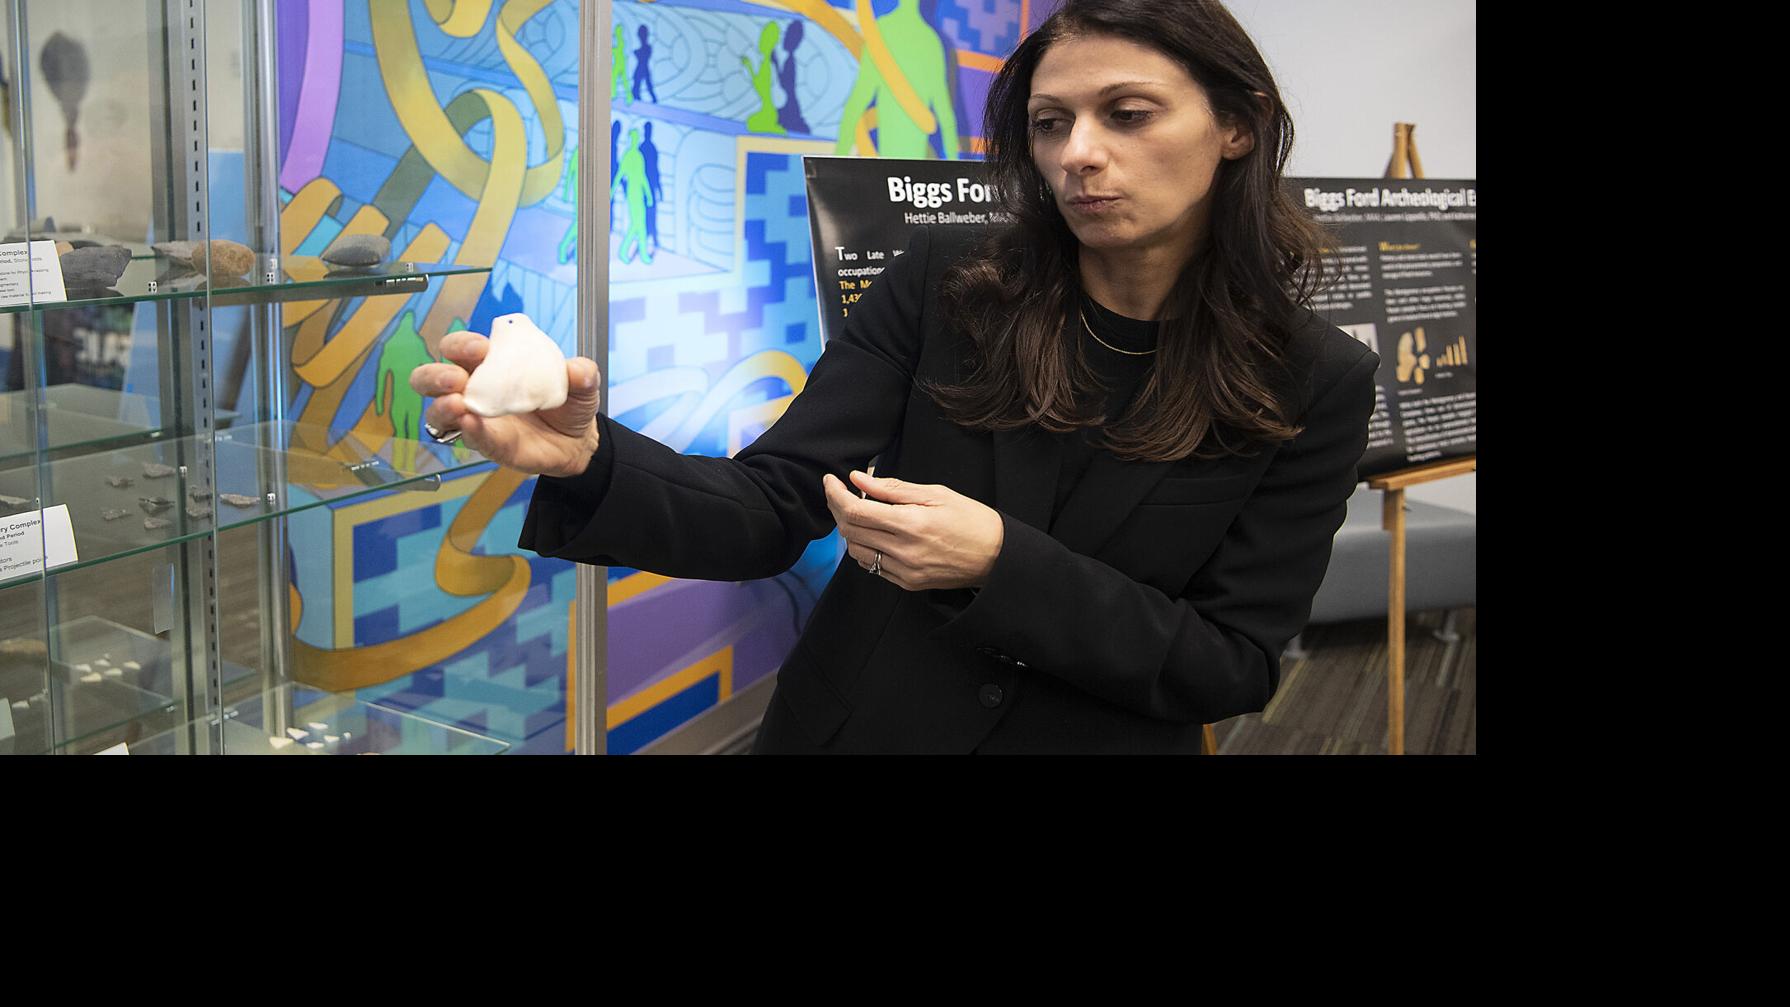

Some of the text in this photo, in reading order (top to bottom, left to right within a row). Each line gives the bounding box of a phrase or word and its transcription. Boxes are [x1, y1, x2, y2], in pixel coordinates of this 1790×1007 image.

[887, 176, 953, 209] Biggs
[1304, 187, 1346, 212] Biggs
[1345, 187, 1380, 208] Ford
[904, 212, 936, 224] Hettie
[937, 211, 988, 225] Ballweber,
[834, 246, 859, 261] Two
[866, 250, 886, 260] Late
[839, 280, 857, 290] The
[9, 520, 41, 530] Complex
